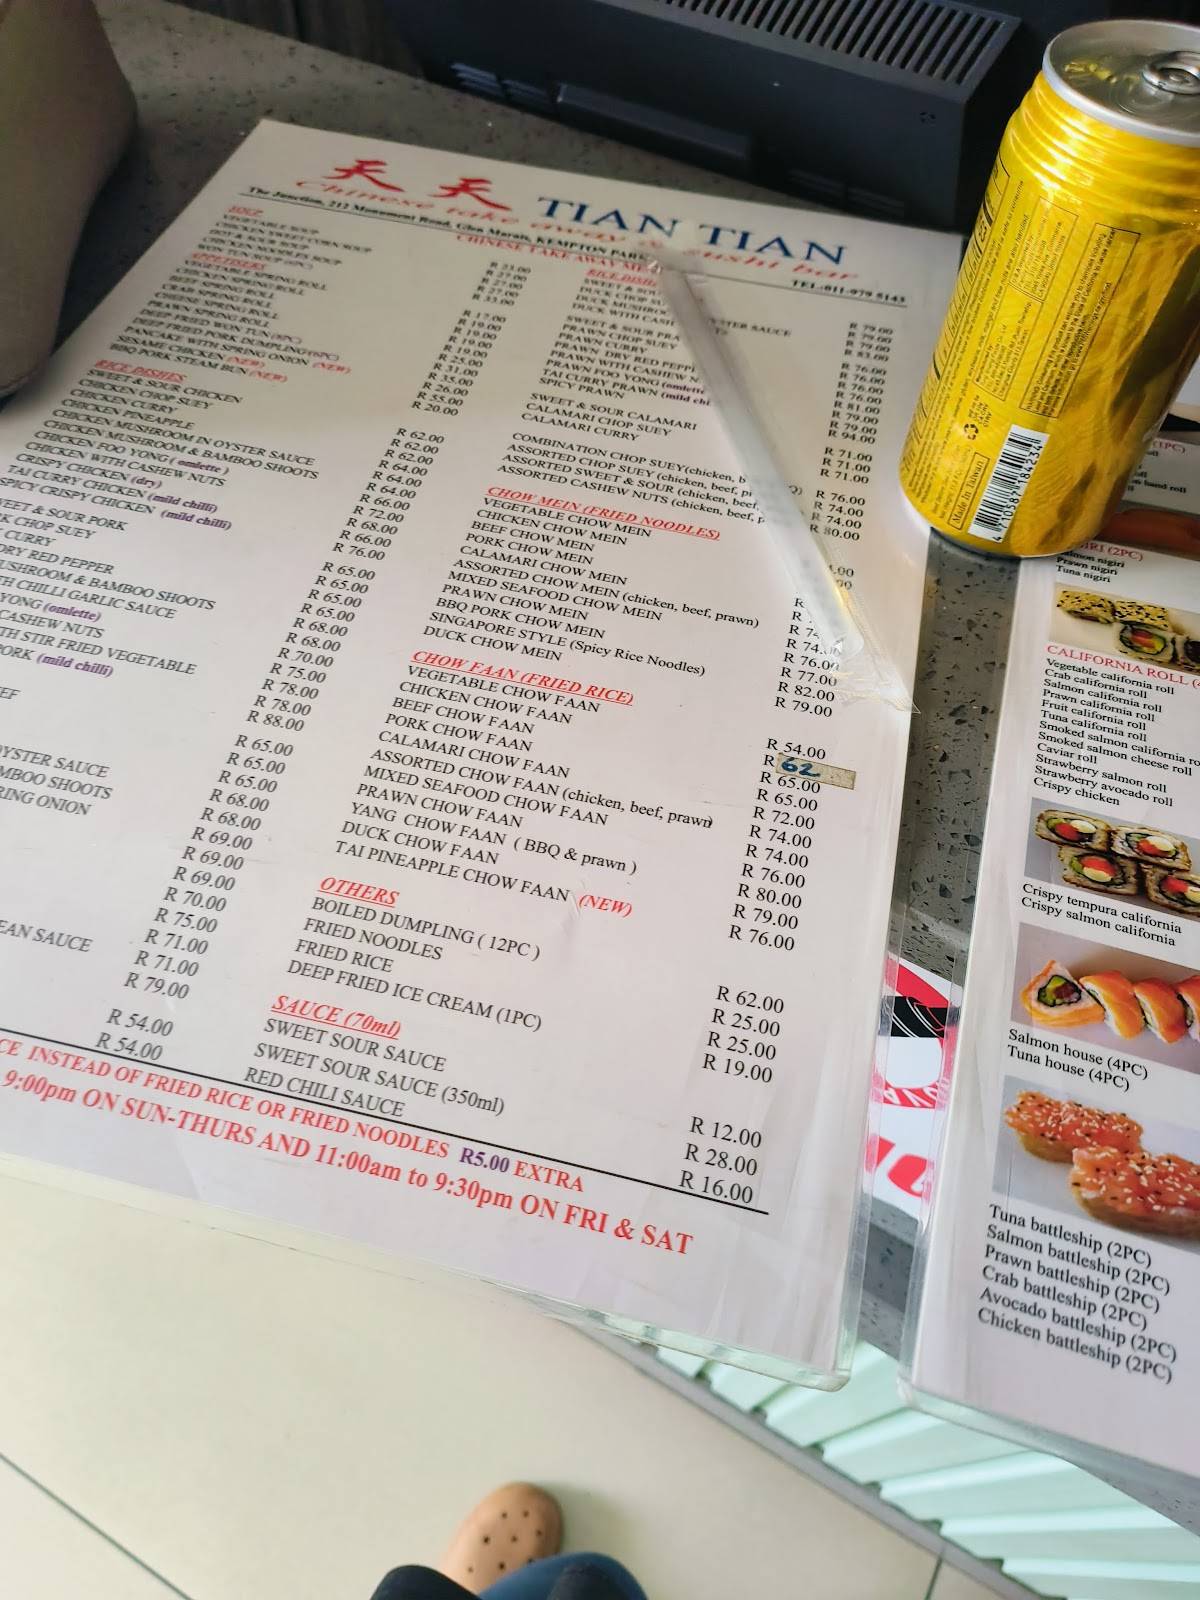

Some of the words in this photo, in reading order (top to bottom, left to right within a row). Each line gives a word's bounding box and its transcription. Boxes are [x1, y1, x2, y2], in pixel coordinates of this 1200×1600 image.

[296, 180, 434, 209] Chinese
[447, 206, 519, 224] take
[793, 263, 859, 280] bar
[456, 233, 524, 251] CHINESE
[529, 245, 573, 259] TAKE
[575, 253, 621, 268] AWAY
[538, 196, 682, 238] TIAN
[699, 223, 847, 265] TIAN
[558, 332, 603, 346] PRAWN
[605, 341, 648, 354] CURRY
[411, 400, 422, 410] R
[423, 403, 459, 416] 20.00
[539, 377, 576, 389] SPICY
[578, 384, 625, 399] PRAWN
[52, 409, 114, 426] CHICKEN
[114, 420, 195, 442] MUSHROOM
[195, 436, 213, 445] IN
[213, 440, 267, 457] OYSTER
[268, 450, 315, 466] SAUCE
[396, 428, 407, 437] R
[409, 431, 445, 444] 62.00
[512, 433, 608, 457] COMBINATION
[609, 452, 647, 464] CHOP
[649, 459, 735, 483] SUEY(chicken,
[8, 464, 32, 476] TAI
[32, 470, 83, 486] CURRY
[82, 479, 148, 498] CHICKEN
[147, 493, 182, 505] (mild
[182, 500, 218, 514] chilli)
[15, 453, 68, 469] CRISPY
[66, 463, 131, 481] CHICKEN
[130, 476, 163, 489] (dry)
[486, 487, 537, 504] CHOW
[536, 496, 581, 514] MEIN
[581, 506, 638, 524] (FRIED
[639, 516, 720, 540] NOODLES)
[953, 501, 966, 523] Made
[332, 542, 345, 553] R
[349, 545, 386, 561] 76.00
[1056, 564, 1080, 577] Tuna
[1083, 572, 1111, 583] nigiri
[453, 559, 530, 580] ASSORTED
[532, 574, 579, 590] CHOW
[580, 583, 620, 598] MEIN
[622, 592, 678, 612] (chicken,
[682, 603, 712, 619] beef,
[714, 613, 759, 629] prawn)
[20, 631, 56, 647] STIR
[56, 638, 104, 656] FRIED
[108, 647, 197, 675] VEGETABLE
[429, 611, 516, 637] SINGAPORE
[517, 629, 567, 647] STYLE
[569, 640, 612, 658] (Spicy
[614, 648, 644, 663] Rice
[647, 654, 705, 677] Noodles)
[1047, 645, 1144, 675] CALIFORNIA
[1147, 667, 1189, 686] ROLL
[411, 651, 469, 673] CHOW
[467, 661, 519, 683] FAAN
[519, 672, 582, 696] (FRIED
[584, 685, 634, 706] RICE)
[777, 681, 789, 693] R
[794, 685, 835, 702] 82.00
[1046, 658, 1098, 677] Vegetable
[1100, 673, 1153, 690] california
[1155, 685, 1174, 695] roll
[763, 754, 775, 768] R
[766, 738, 778, 751] R
[783, 742, 826, 760] 54.00
[781, 757, 821, 777] 62
[1038, 731, 1084, 750] Smoked
[1086, 745, 1128, 760] salmon
[1130, 754, 1169, 770] cheese
[1172, 766, 1192, 776] roll
[318, 877, 400, 908] OTHERS
[336, 840, 365, 858] TAI
[367, 847, 460, 878] PINEAPPLE
[462, 868, 518, 890] CHOW
[520, 880, 570, 902] FAAN
[163, 886, 178, 902] R
[183, 890, 227, 912] 70.00
[1022, 883, 1063, 904] Crispy
[1067, 896, 1118, 917] tempura
[1121, 911, 1182, 934] california
[271, 995, 344, 1027] SAUCE
[341, 1012, 401, 1040] (70ml)
[287, 959, 335, 981] DEEP
[335, 970, 390, 994] FRIED
[392, 983, 424, 1003] ICE
[426, 991, 493, 1019] CREAM
[496, 1007, 542, 1032] (1PC)
[1009, 1028, 1059, 1053] Salmon
[1063, 1043, 1103, 1065] house
[1107, 1056, 1148, 1080] (4PC)
[253, 1042, 320, 1069] SWEET
[320, 1057, 371, 1082] SOUR
[374, 1070, 439, 1098] SAUCE
[441, 1086, 505, 1117] (350ml)
[28, 1046, 112, 1077] INSTEAD
[114, 1066, 143, 1084] OF
[143, 1072, 203, 1099] FRIED
[204, 1087, 254, 1111] RICE
[256, 1100, 286, 1120] OR
[289, 1107, 350, 1134] FRIED
[353, 1122, 450, 1158] NOODLES
[459, 1147, 510, 1173] R5.00
[513, 1160, 583, 1193] EXTRA
[2, 1070, 77, 1103] 9:00pm
[82, 1088, 120, 1111] ON
[120, 1097, 256, 1145] SUN-THURS
[257, 1132, 311, 1158] AND
[315, 1144, 402, 1182] 11:00am
[408, 1168, 429, 1188] to
[434, 1172, 513, 1210] 9:30pm
[520, 1194, 560, 1220] ON
[563, 1204, 609, 1233] FRI
[613, 1218, 634, 1241] &
[641, 1224, 694, 1255] SAT
[684, 1143, 699, 1163] R
[705, 1148, 758, 1176] 28.00
[989, 1204, 1026, 1228] Tuna
[1031, 1216, 1103, 1254] battleship
[1107, 1241, 1152, 1269] (2PC)
[978, 1307, 1041, 1341] Chicken
[1046, 1328, 1123, 1369] battleship
[1125, 1354, 1172, 1385] (2PC)
